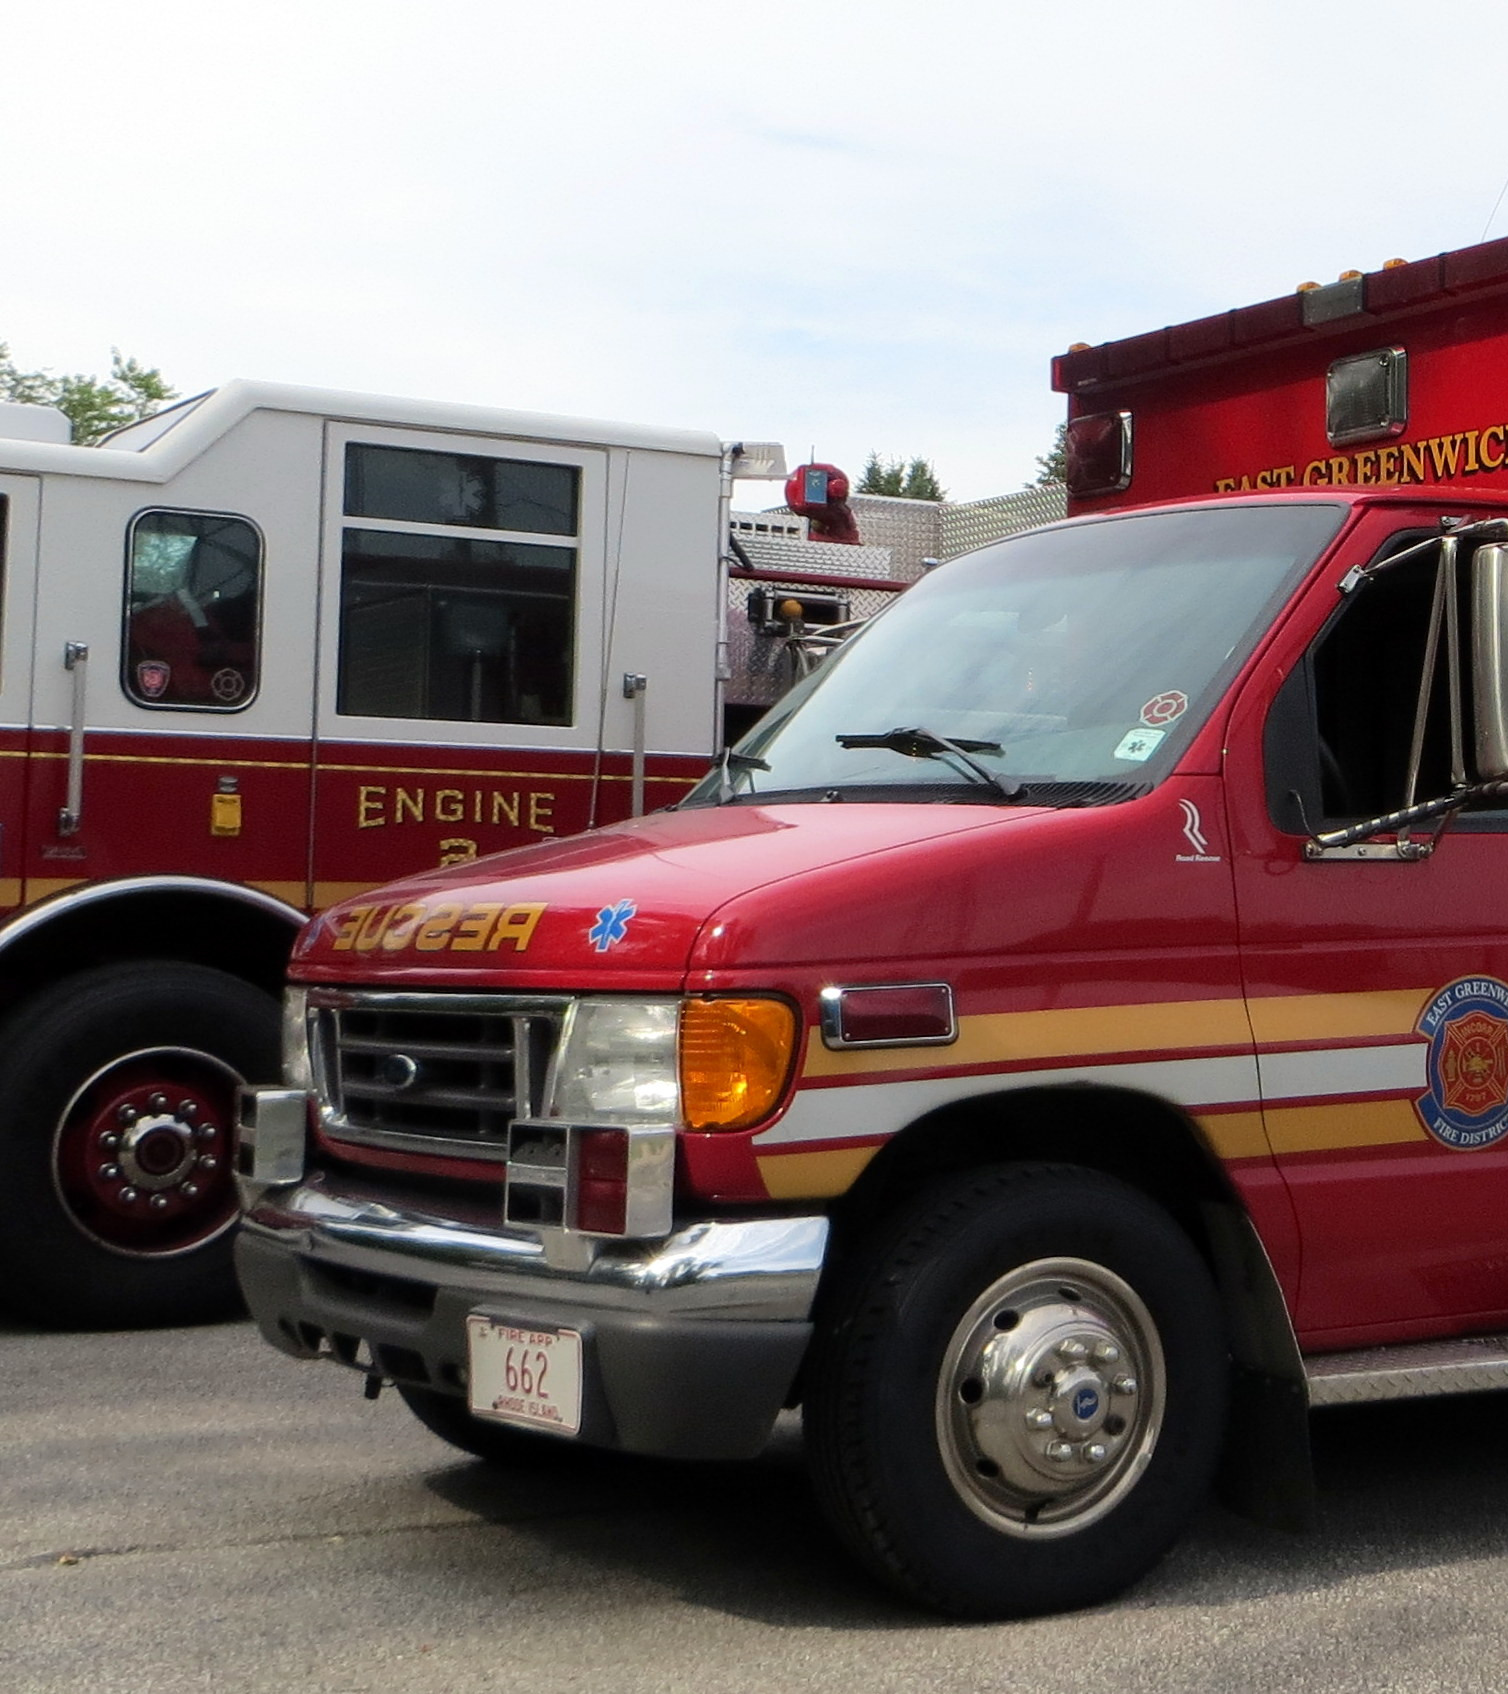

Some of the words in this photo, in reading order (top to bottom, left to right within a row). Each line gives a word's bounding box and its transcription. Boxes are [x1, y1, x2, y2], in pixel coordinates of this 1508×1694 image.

[358, 785, 555, 834] ENGINE
[1426, 991, 1452, 1026] EAST
[1433, 1116, 1457, 1141] FIRE
[498, 1327, 525, 1343] FIRE
[505, 1346, 549, 1399] 662
